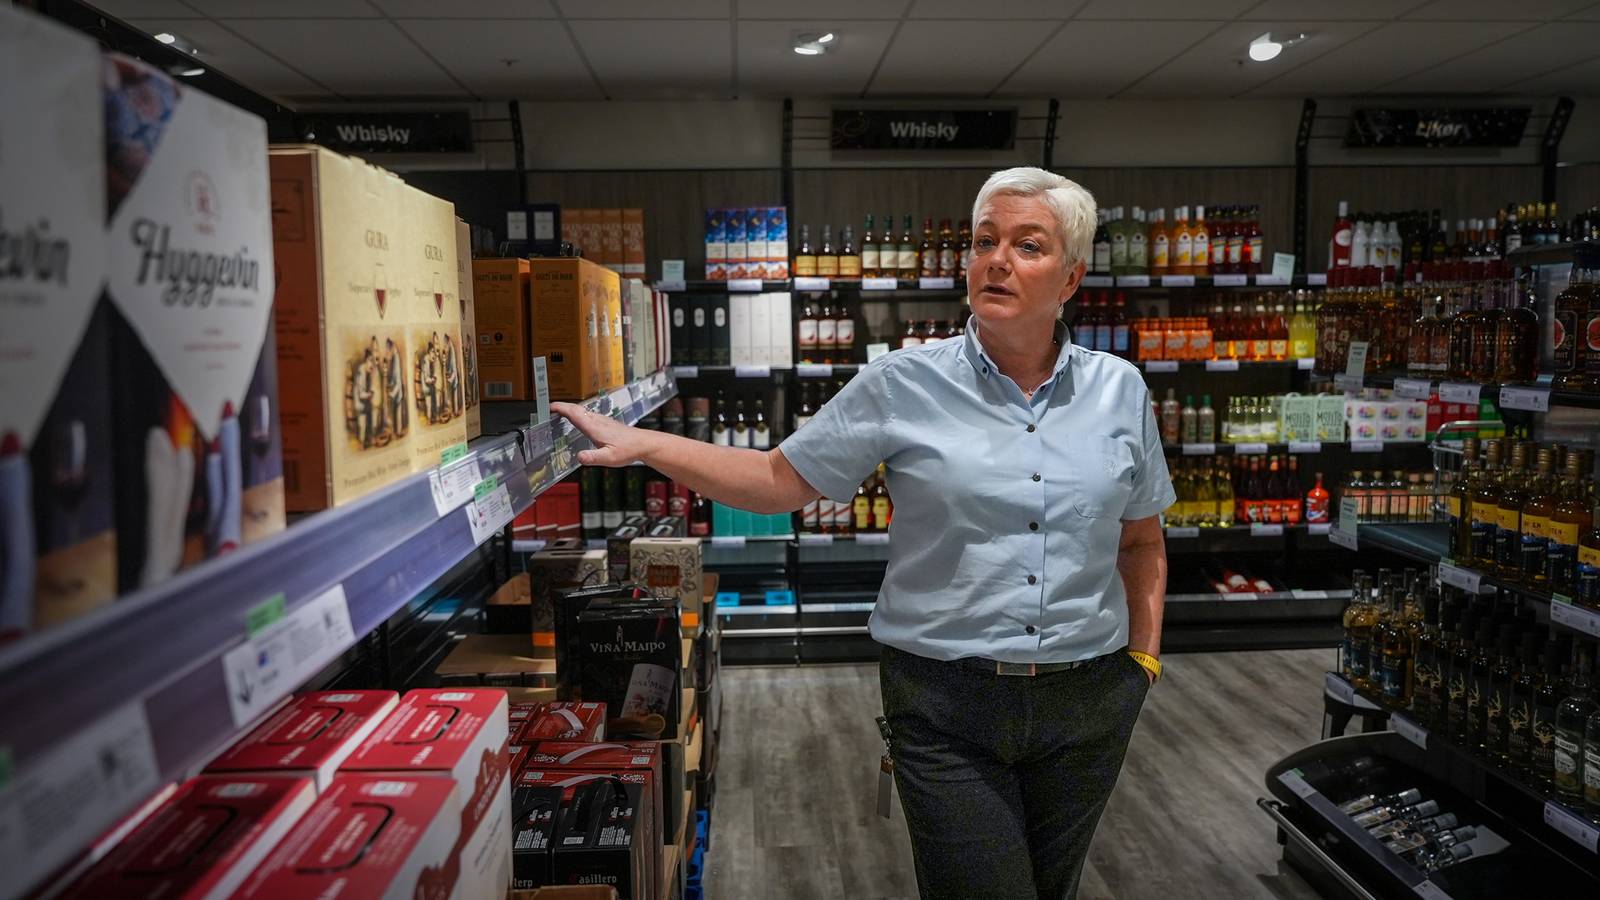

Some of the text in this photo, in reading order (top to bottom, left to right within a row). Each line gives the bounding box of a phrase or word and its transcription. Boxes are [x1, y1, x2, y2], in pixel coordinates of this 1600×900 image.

[336, 124, 411, 145] Whisky
[890, 121, 959, 142] Whisky
[130, 217, 260, 307] Hyggevin
[424, 244, 444, 262] GURA
[590, 640, 666, 654] VIÑA MAIPO
